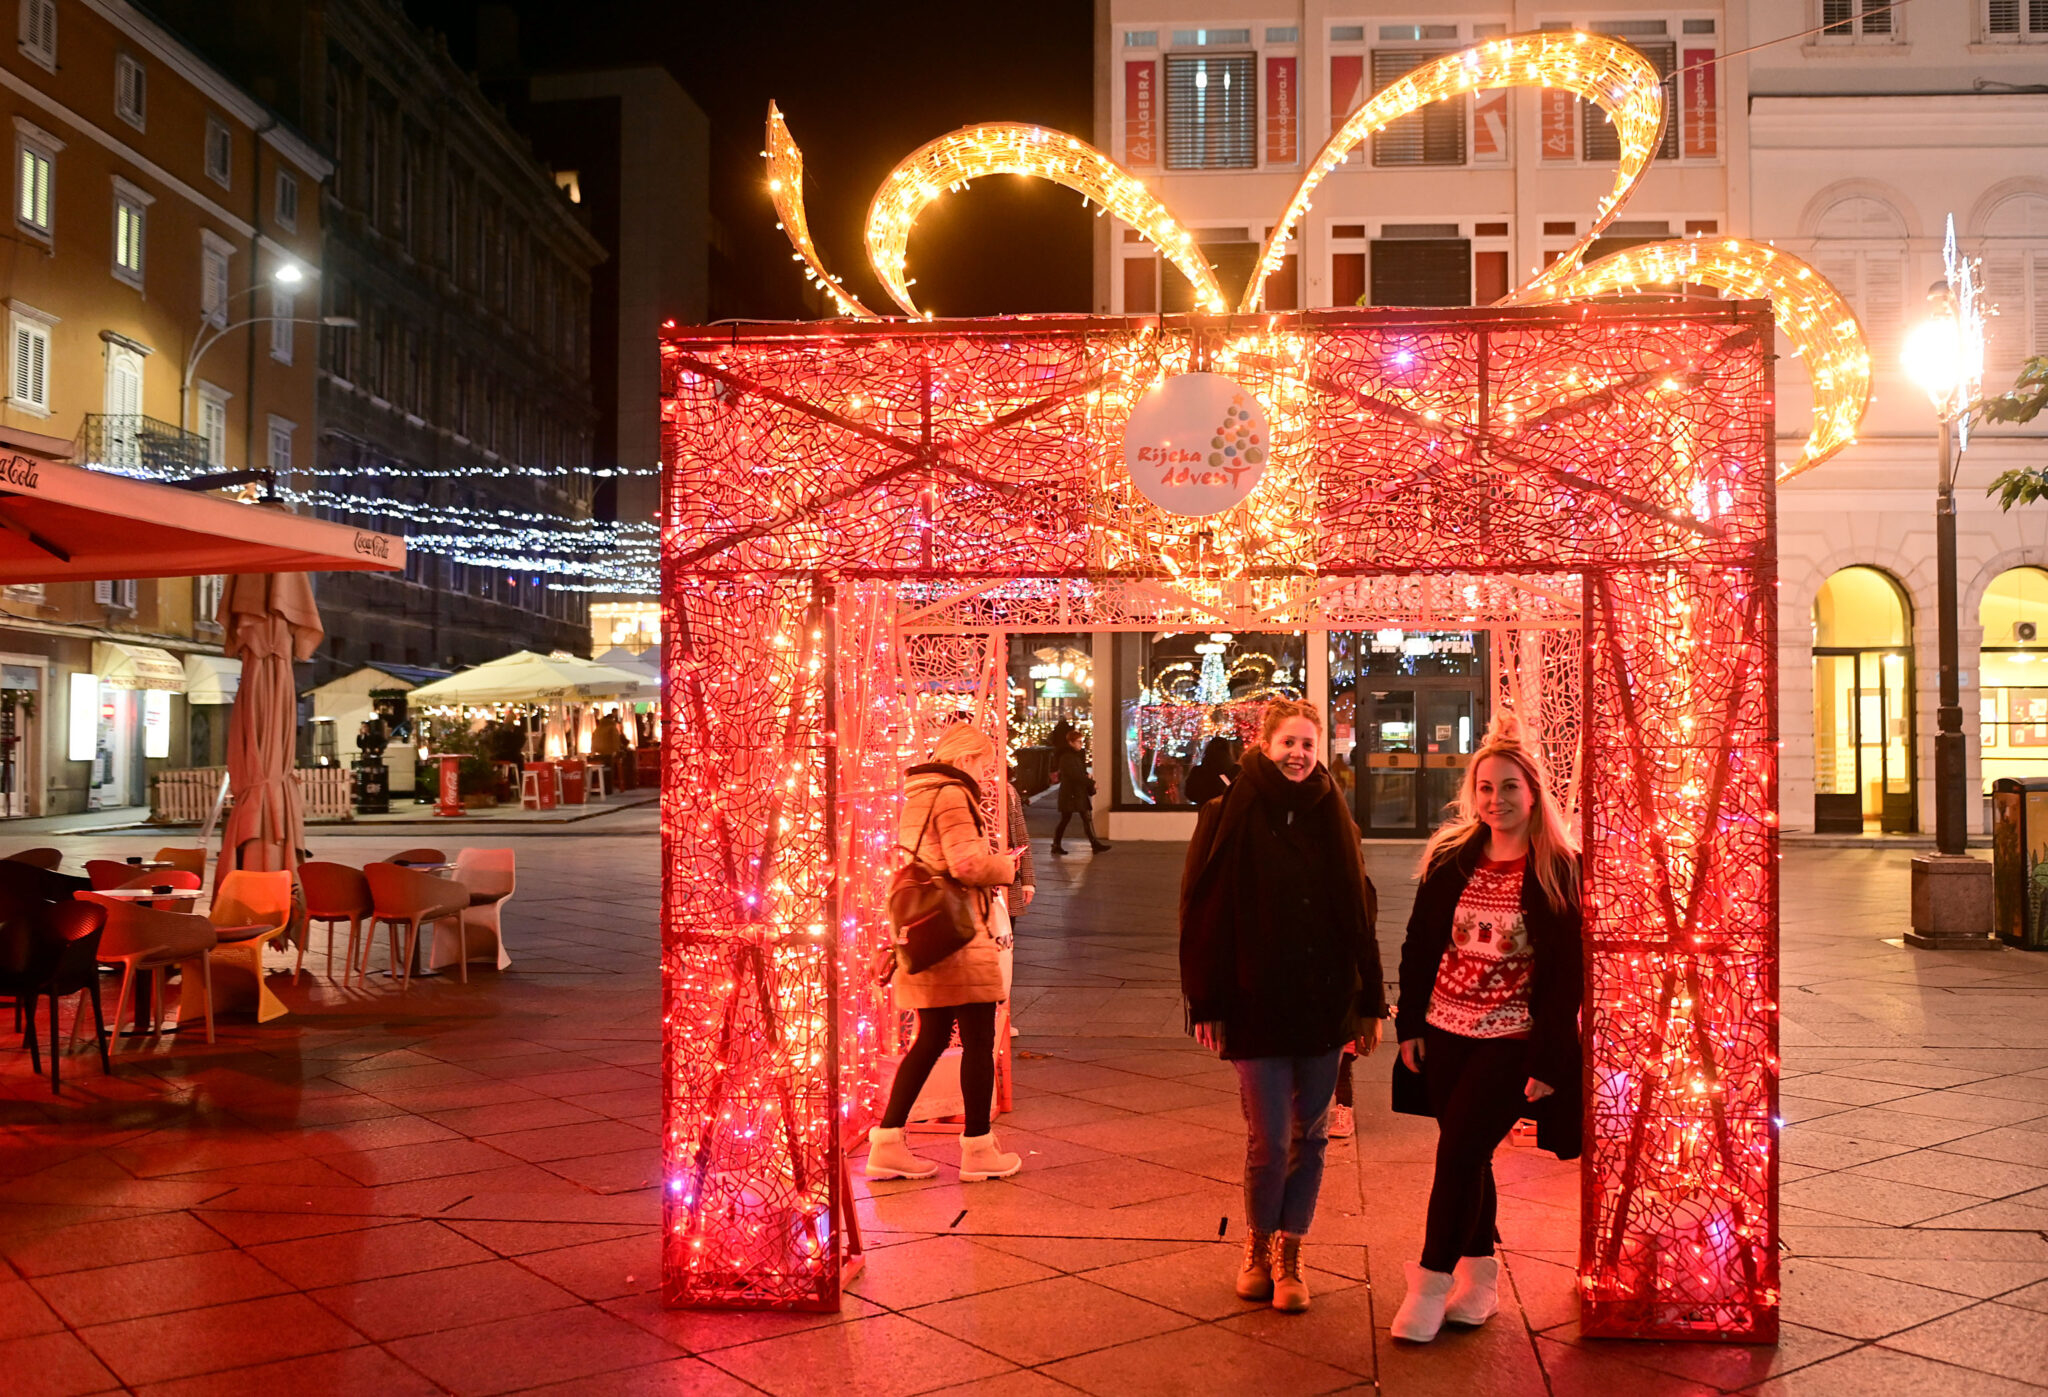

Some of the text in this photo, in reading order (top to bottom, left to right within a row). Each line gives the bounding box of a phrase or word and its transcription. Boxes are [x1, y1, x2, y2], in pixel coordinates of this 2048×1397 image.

[1138, 69, 1150, 140] ALGEBRA
[1277, 67, 1290, 157] www.algebra.hr
[1554, 92, 1565, 127] ALGE
[1137, 446, 1202, 468] Rijeka
[354, 531, 389, 559] Coca-Cola
